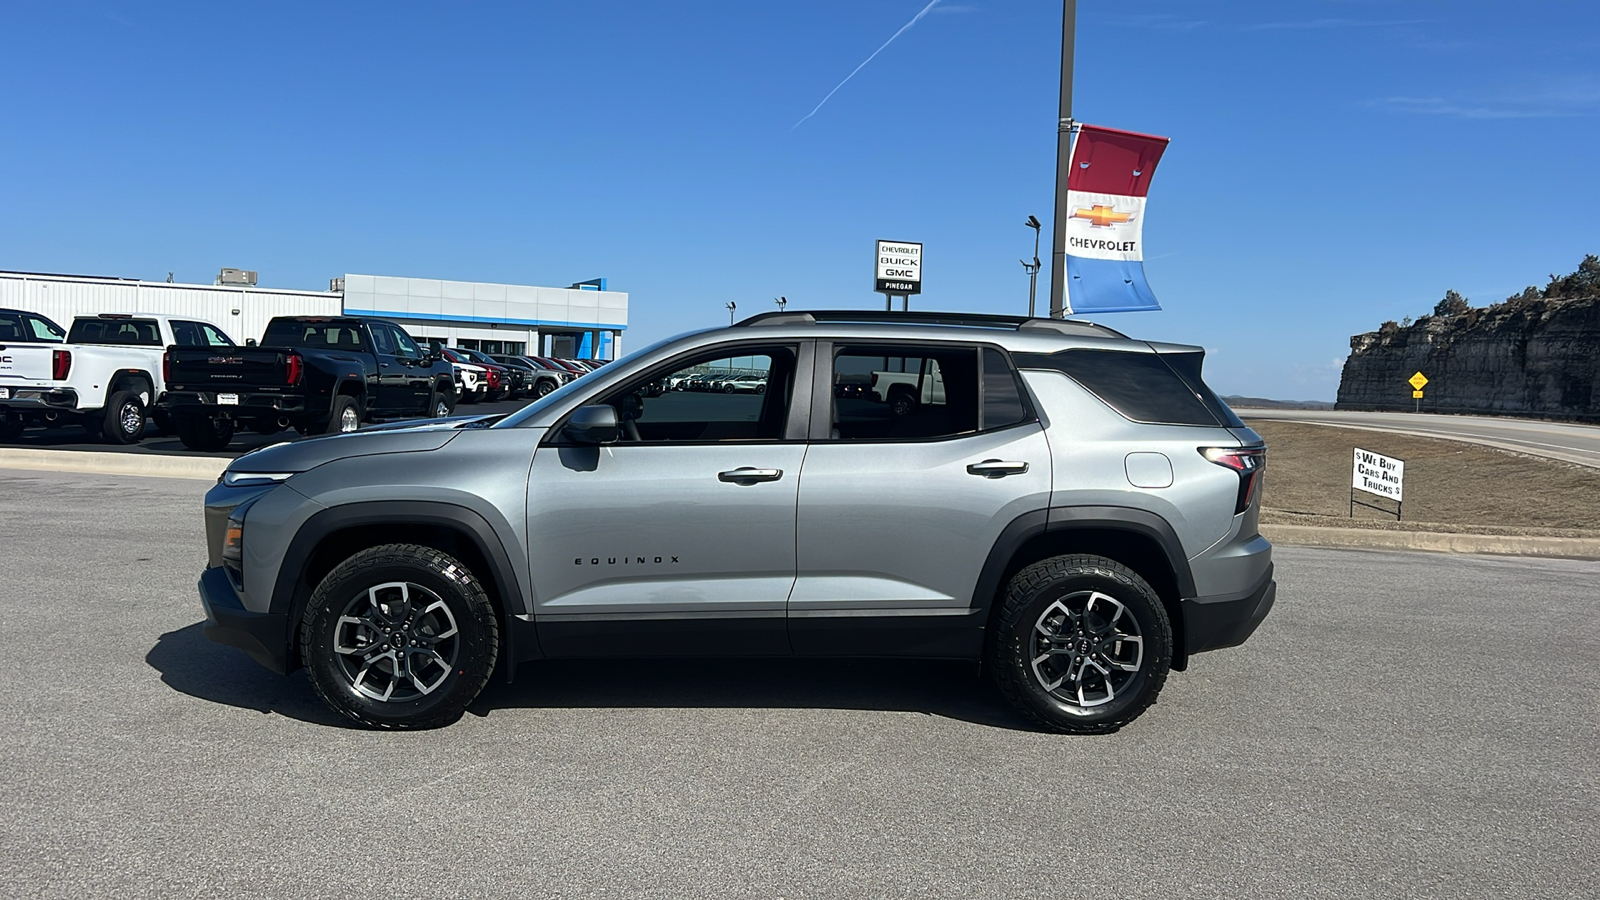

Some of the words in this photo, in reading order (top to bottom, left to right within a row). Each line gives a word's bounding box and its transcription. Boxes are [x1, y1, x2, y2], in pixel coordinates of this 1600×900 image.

[1070, 236, 1136, 252] CHEVROLET
[881, 245, 919, 255] CHEVROLET
[880, 257, 918, 267] BUICK
[885, 268, 914, 278] GMC
[885, 282, 913, 290] PINEGAR
[574, 556, 679, 565] EQUINOX
